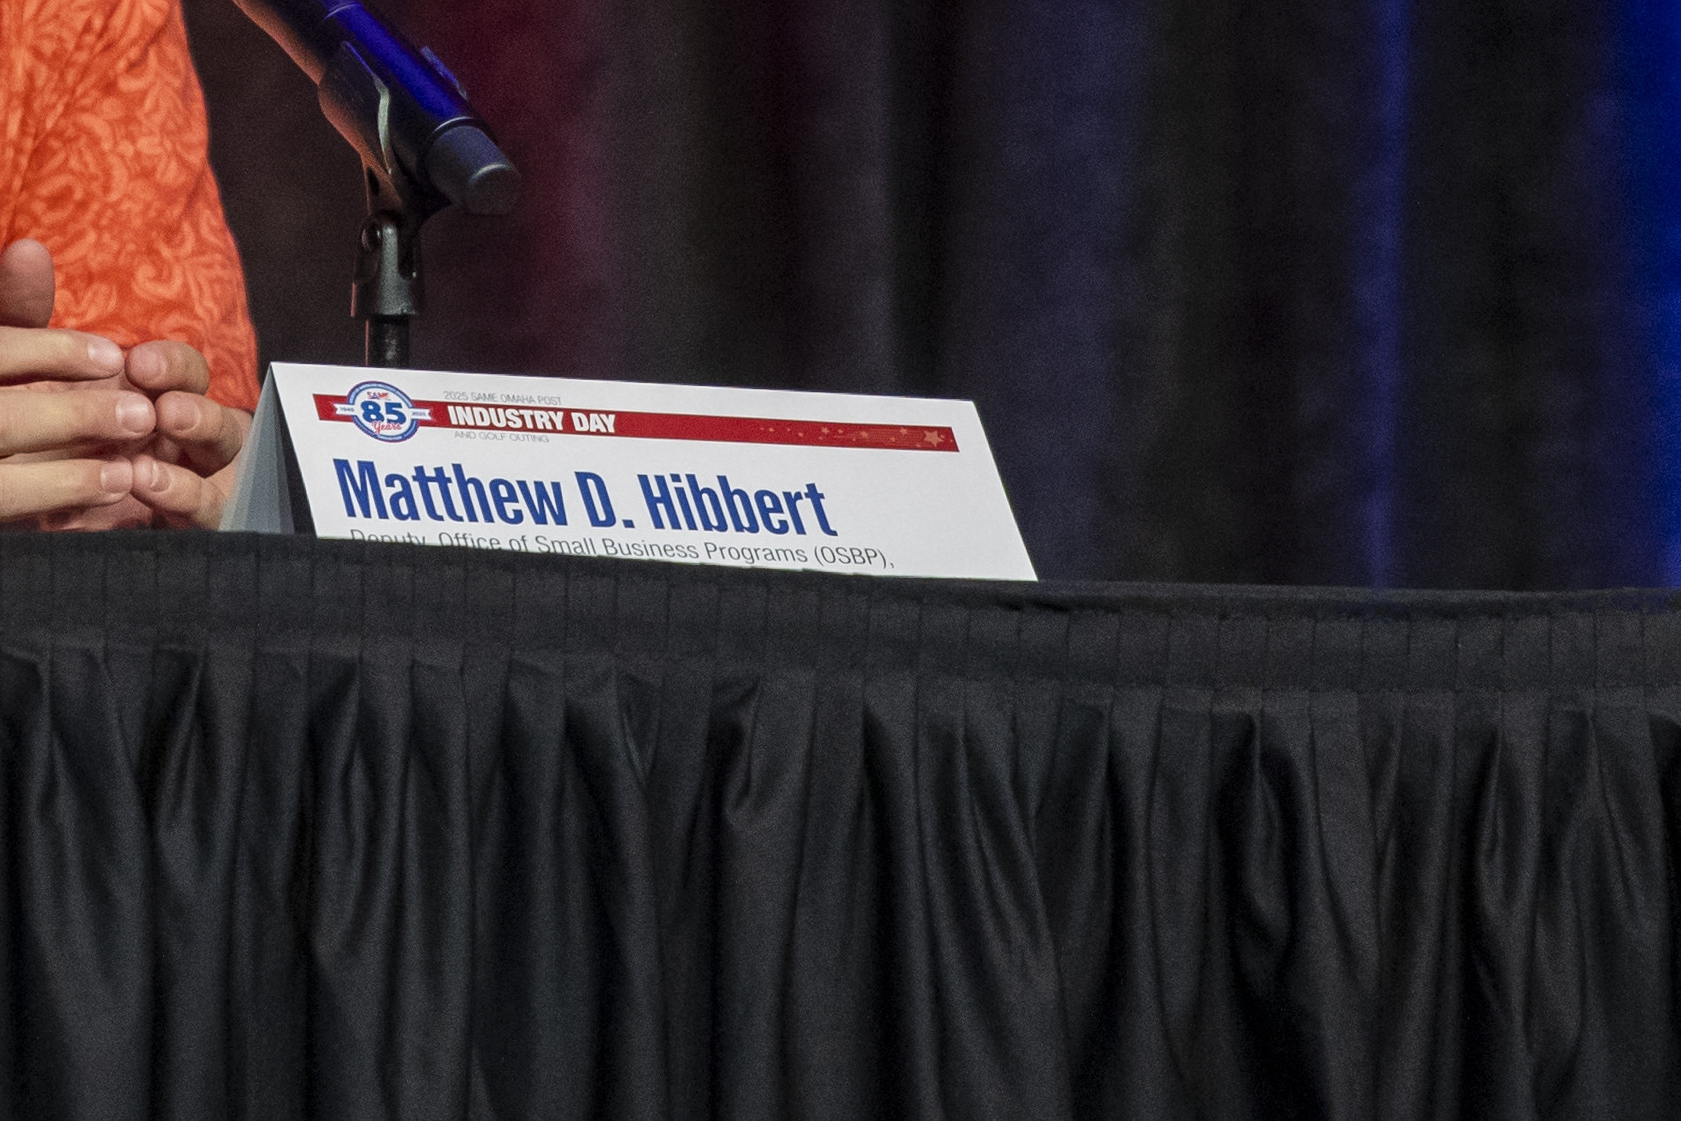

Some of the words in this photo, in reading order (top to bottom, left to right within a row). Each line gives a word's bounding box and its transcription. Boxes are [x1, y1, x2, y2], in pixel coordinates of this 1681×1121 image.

[444, 390, 469, 402] 2025
[470, 392, 497, 403] SAME
[500, 394, 536, 404] OMAHA
[537, 395, 562, 406] POST
[360, 400, 407, 425] 85
[447, 405, 564, 431] INDUSTRY
[571, 412, 616, 433] DAY
[453, 430, 477, 440] AND
[479, 431, 507, 441] GOLF
[509, 433, 550, 443] OUTING
[332, 458, 569, 527] Matthew
[573, 471, 636, 529] D.
[636, 473, 839, 537] Hibbert
[438, 532, 502, 549] Office
[508, 535, 528, 551] of
[535, 535, 597, 555] Small
[601, 538, 700, 559] Business
[703, 542, 808, 564] Programs
[813, 545, 895, 569] (OSBP),
